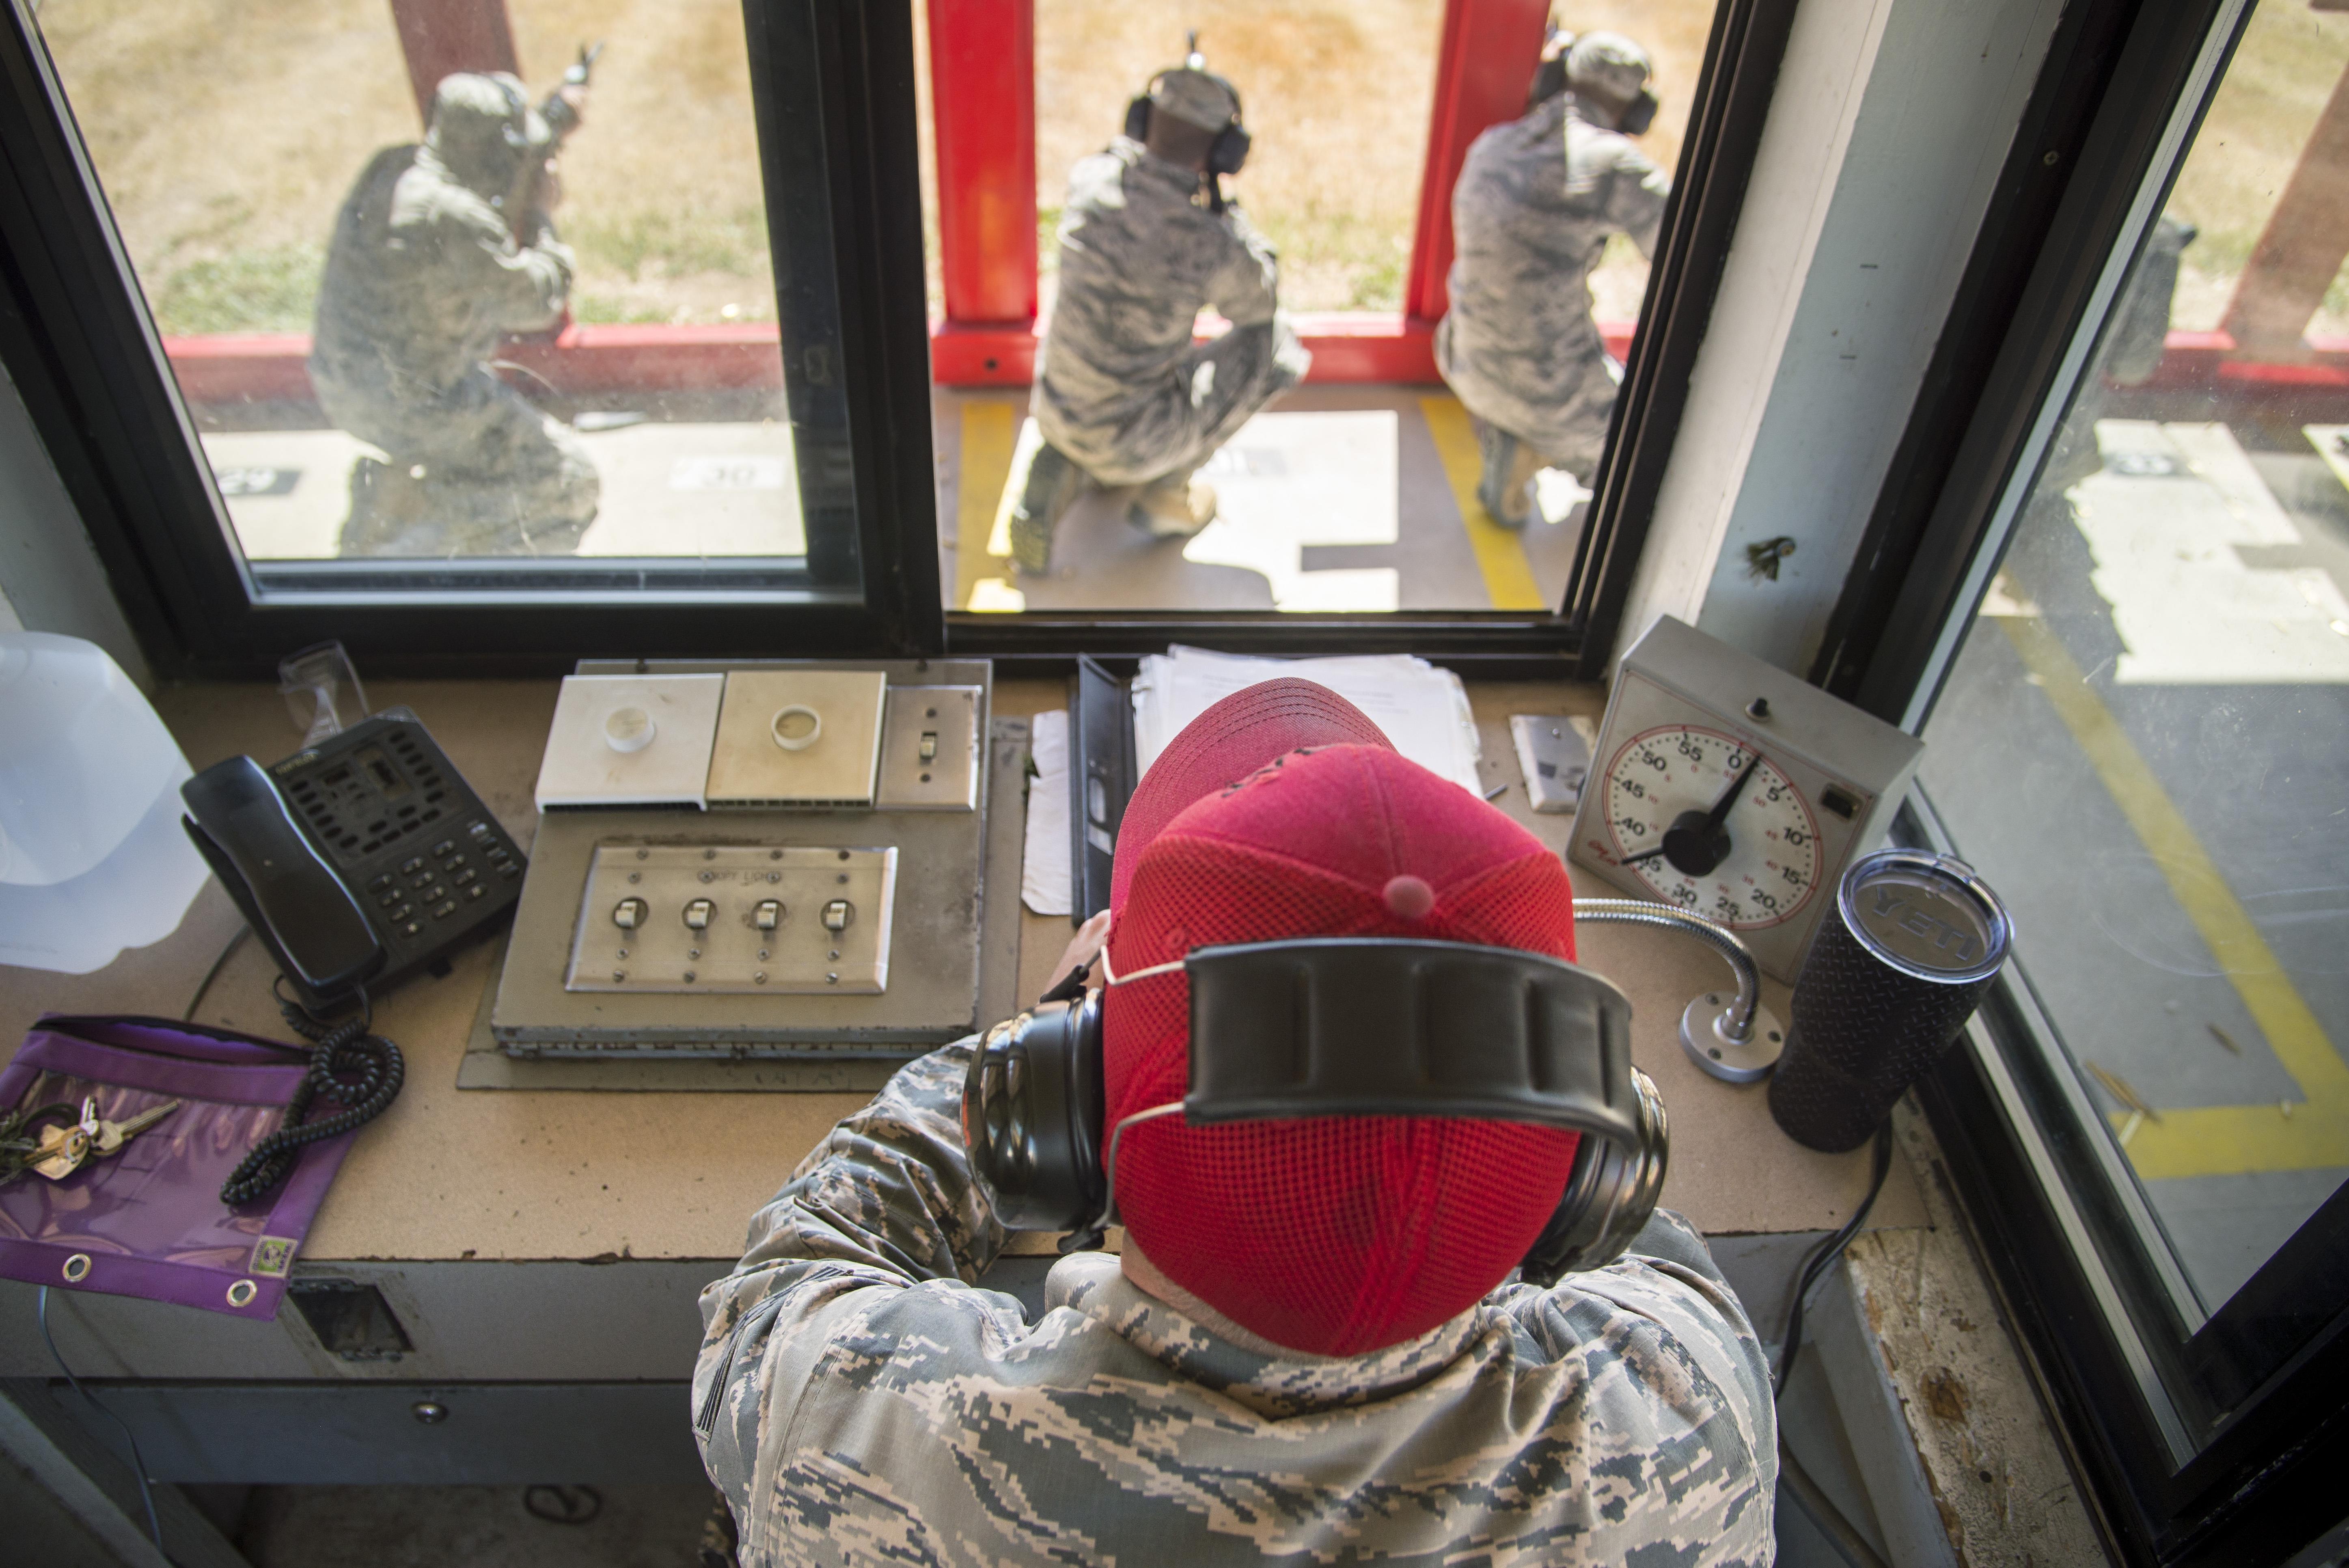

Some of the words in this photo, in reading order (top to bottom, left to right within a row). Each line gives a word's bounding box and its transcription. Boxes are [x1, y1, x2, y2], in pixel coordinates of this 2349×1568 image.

[1642, 751, 1666, 771] 50
[1678, 740, 1702, 762] 55
[1728, 754, 1741, 769] 0
[1621, 779, 1644, 798] 45
[1767, 786, 1780, 801] 5
[1621, 817, 1645, 836] 40
[1783, 826, 1803, 845] 10
[1782, 865, 1799, 885] 15
[1672, 882, 1698, 904] 30
[1750, 888, 1775, 909] 20
[1716, 896, 1740, 917] 25
[1872, 886, 1980, 962] YETI
